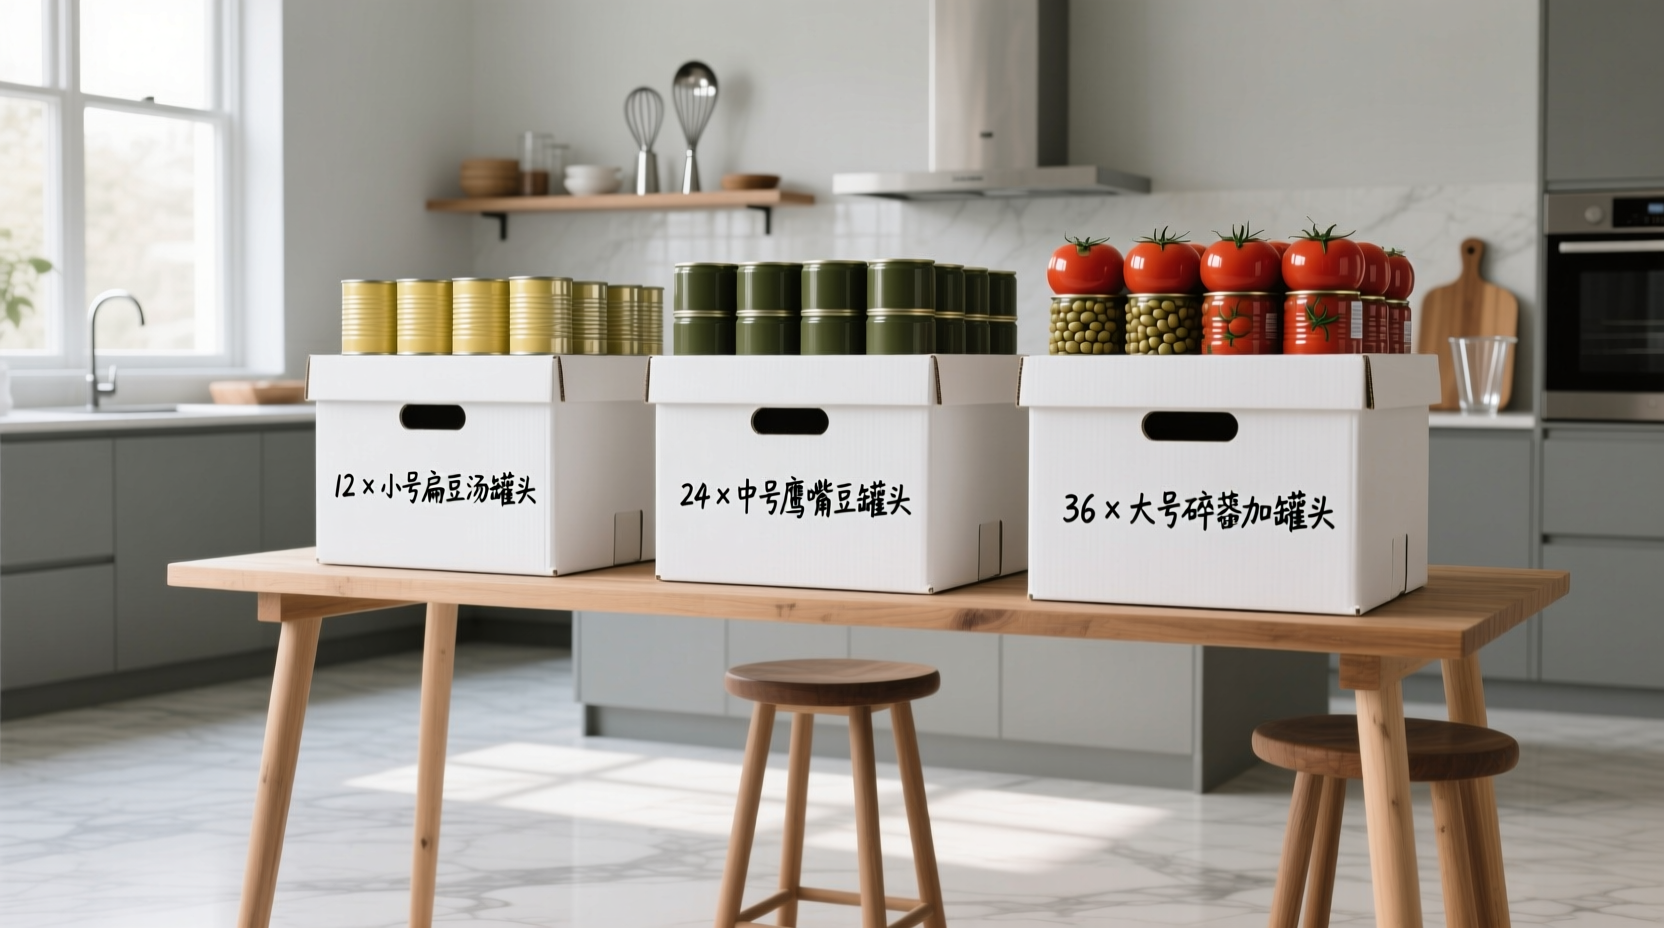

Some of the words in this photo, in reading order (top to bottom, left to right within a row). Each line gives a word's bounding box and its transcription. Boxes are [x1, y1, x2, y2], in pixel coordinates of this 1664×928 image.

[334, 473, 356, 498] 12
[380, 469, 537, 507] 小号扁豆汤罐头
[679, 482, 711, 510] 24
[737, 475, 912, 519] 中号鹰嘴豆罐头
[1062, 493, 1096, 524] 36
